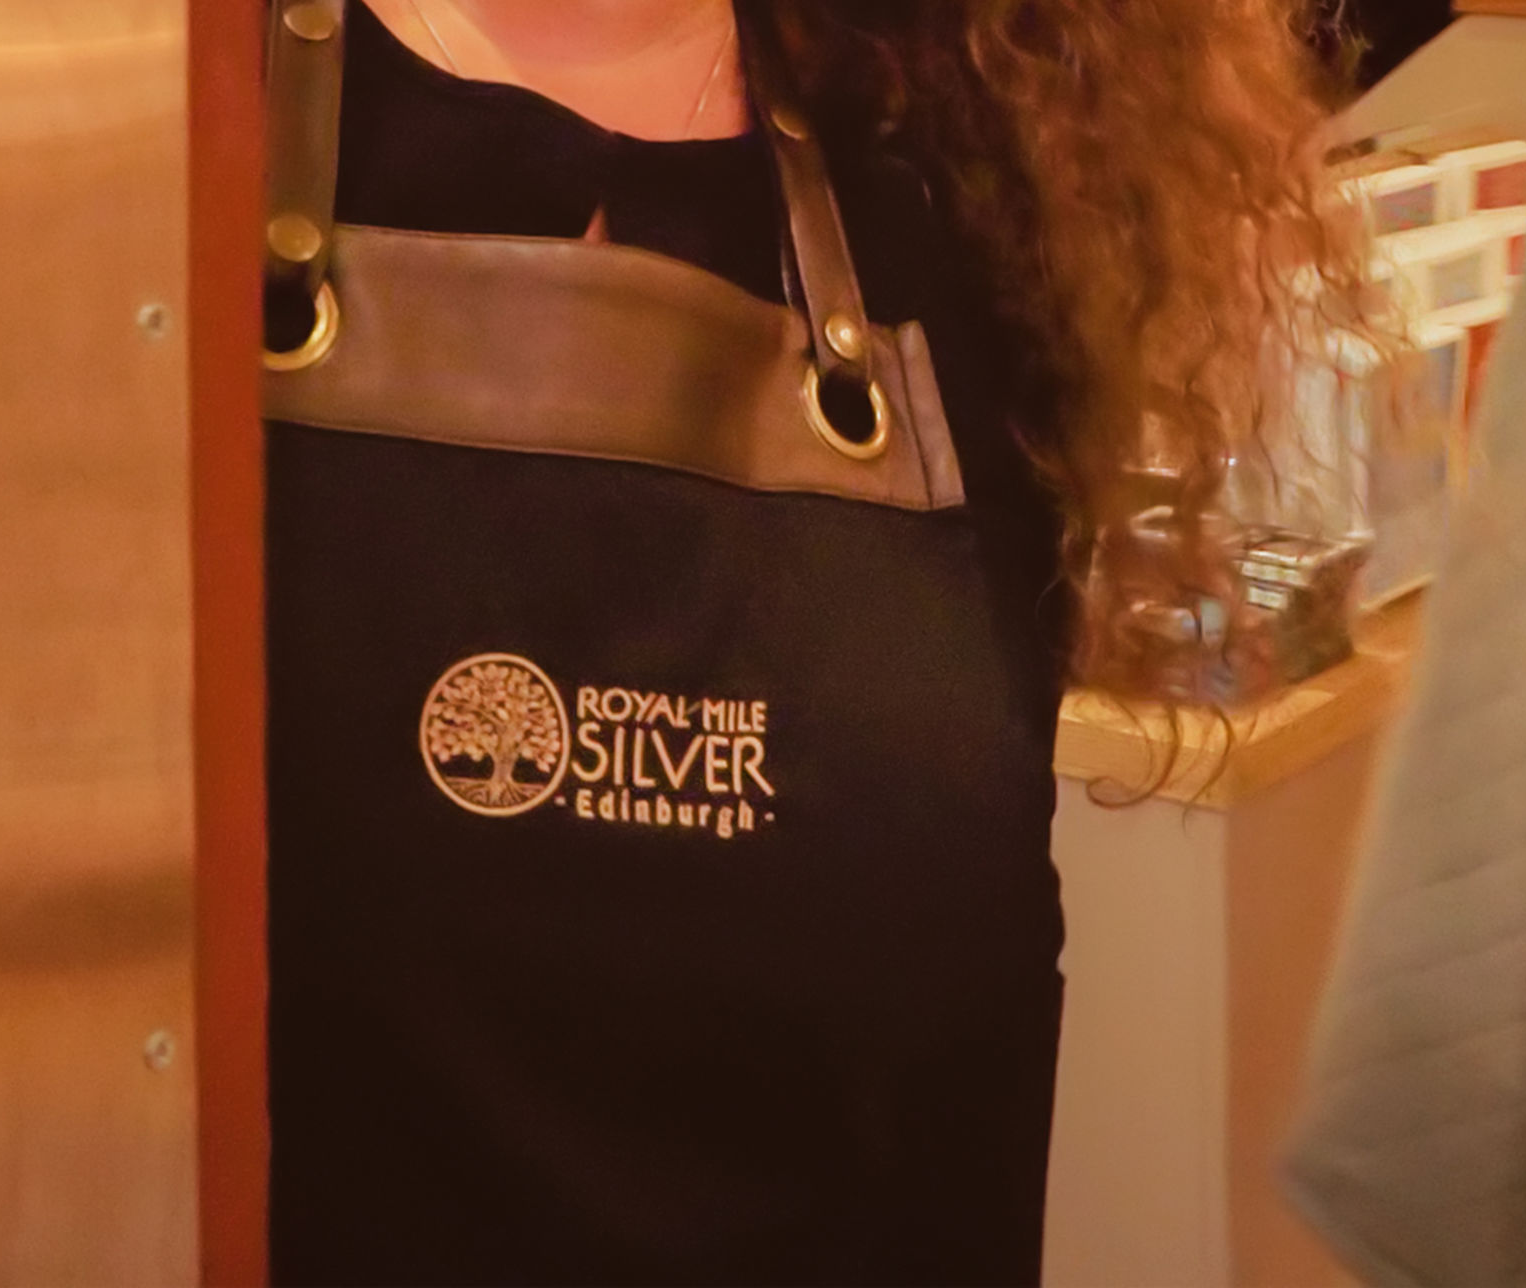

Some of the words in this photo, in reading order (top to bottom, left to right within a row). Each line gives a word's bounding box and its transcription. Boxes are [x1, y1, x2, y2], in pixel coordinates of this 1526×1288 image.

[576, 686, 692, 730] ROYAL
[702, 697, 767, 733] MILE
[573, 721, 775, 796] SILVER
[576, 789, 755, 840] Edinburgh
